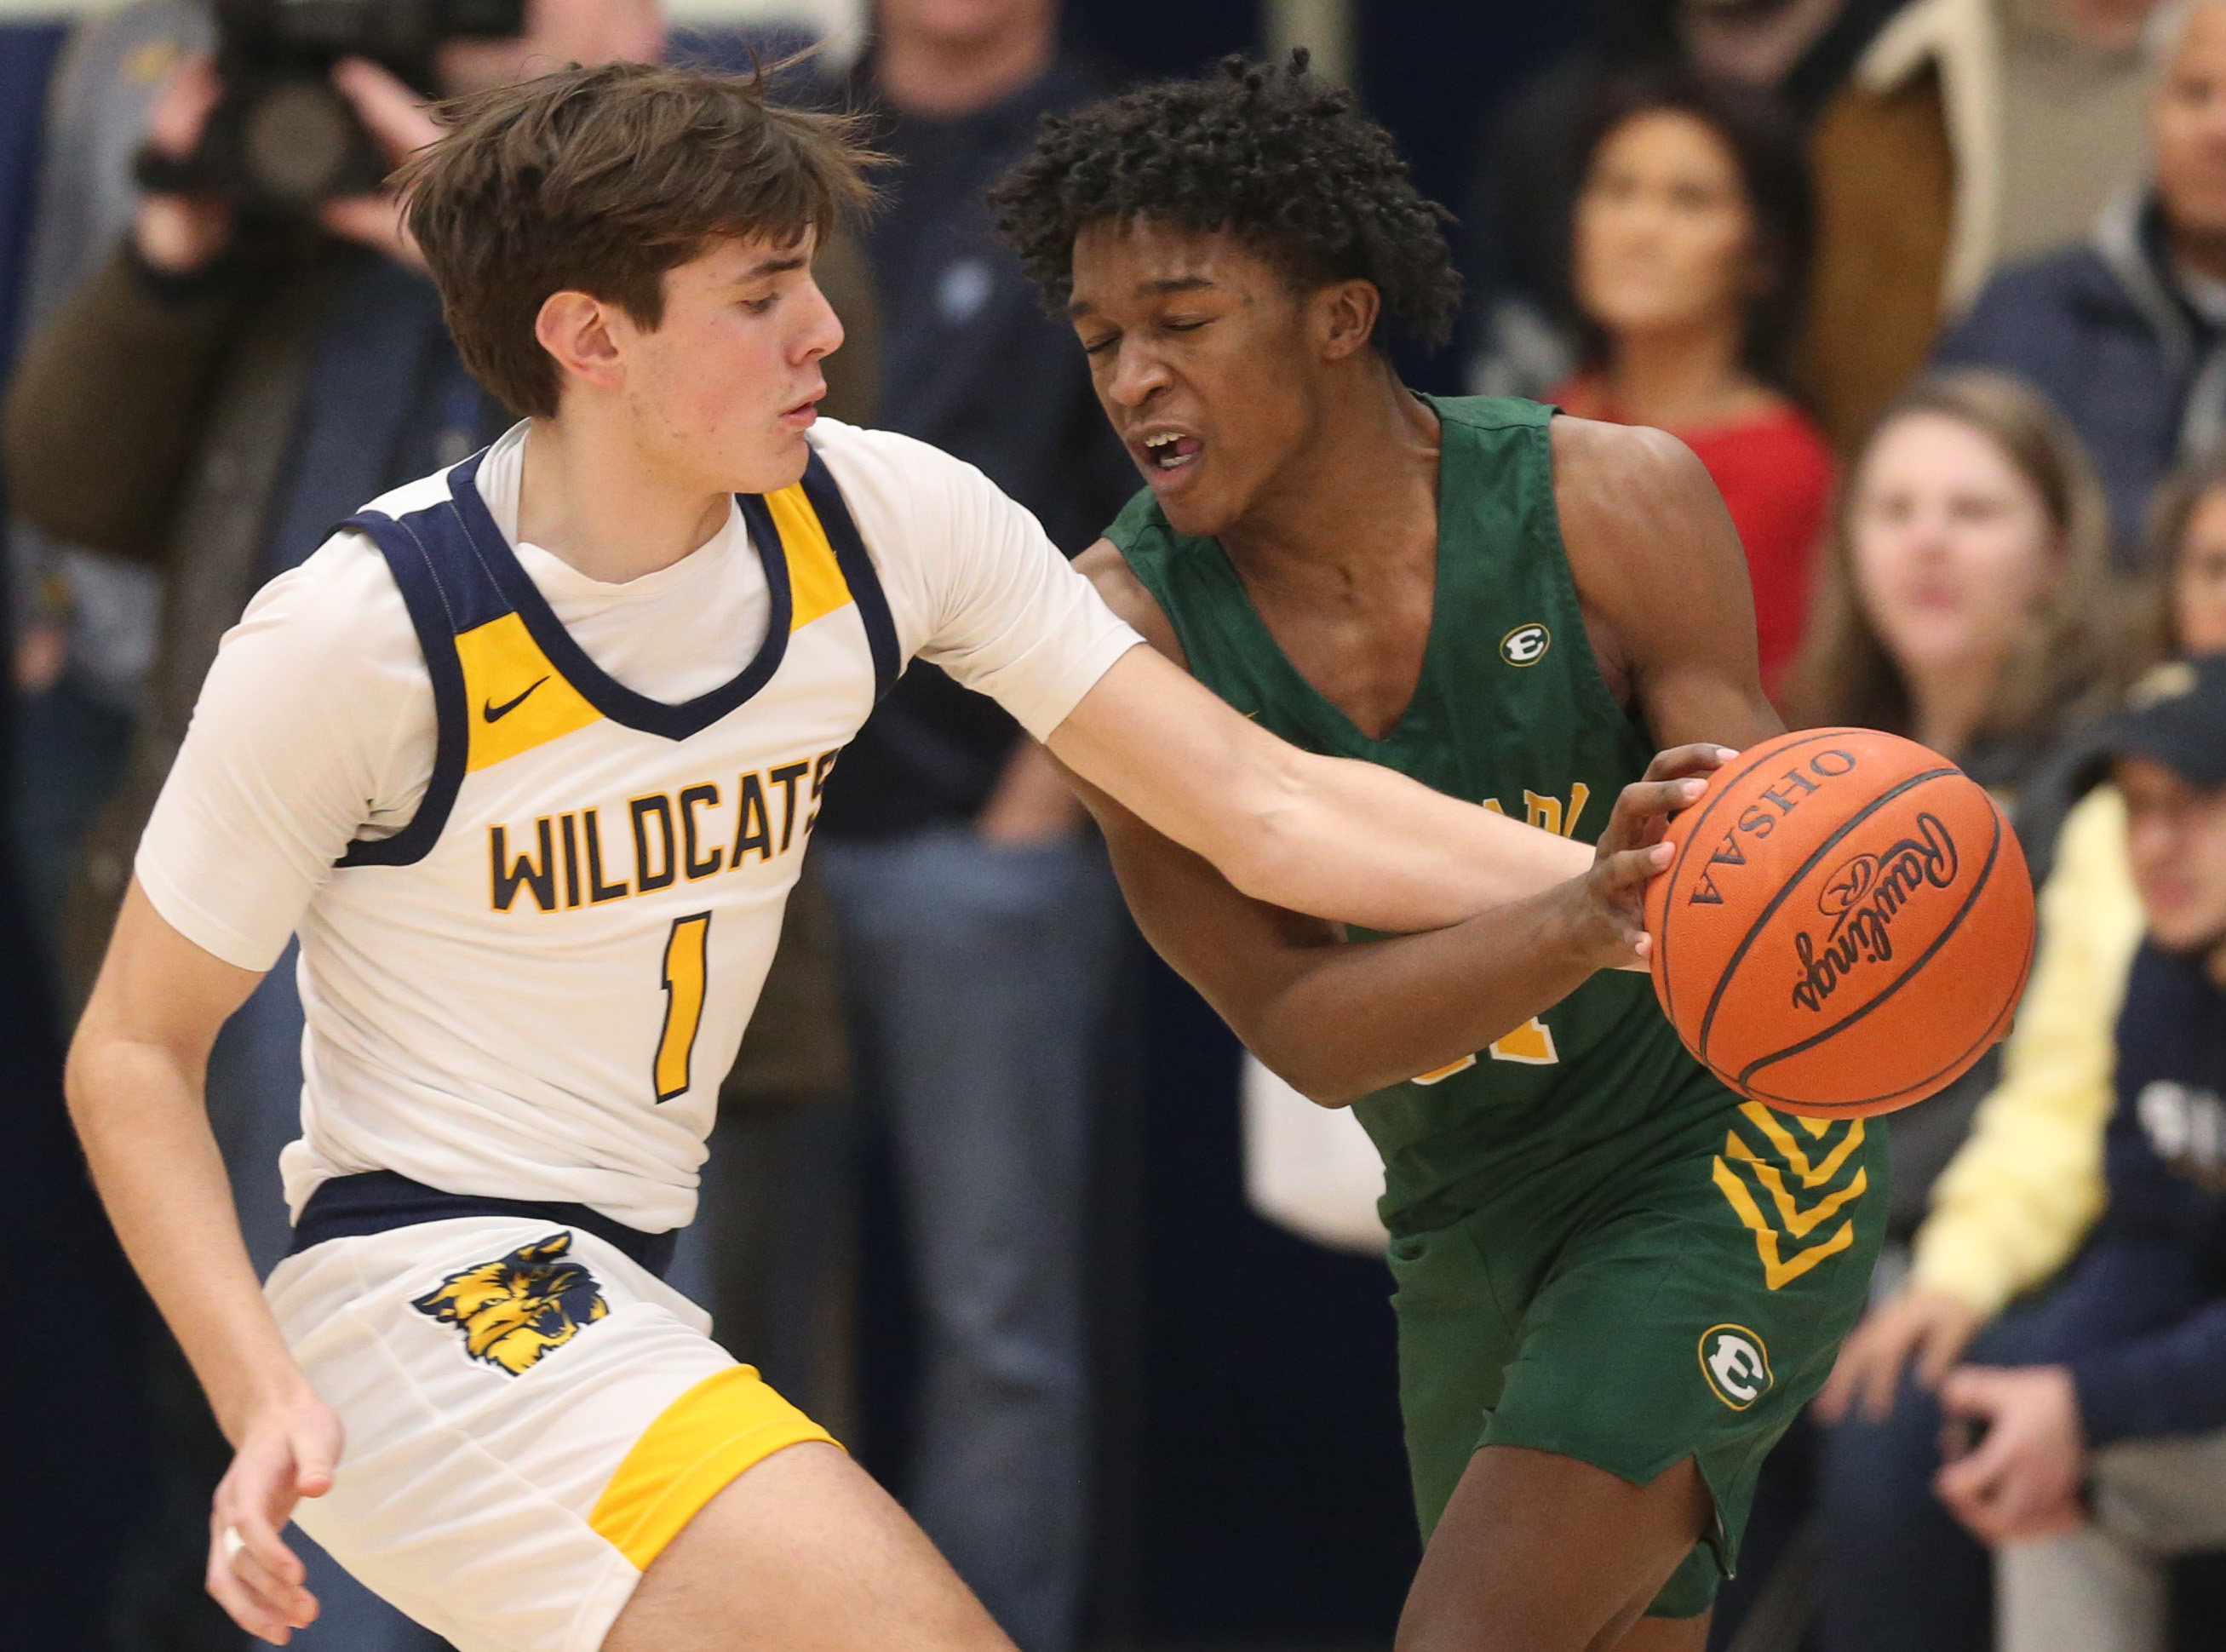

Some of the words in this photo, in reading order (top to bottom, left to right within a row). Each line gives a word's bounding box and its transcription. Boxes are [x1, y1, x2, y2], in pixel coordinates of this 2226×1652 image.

[1506, 628, 1544, 661] E
[1688, 749, 1857, 908] OHSAA
[1793, 812, 1958, 1012] Rawlings
[653, 909, 712, 1104] 1
[1709, 1335, 1764, 1402] E
